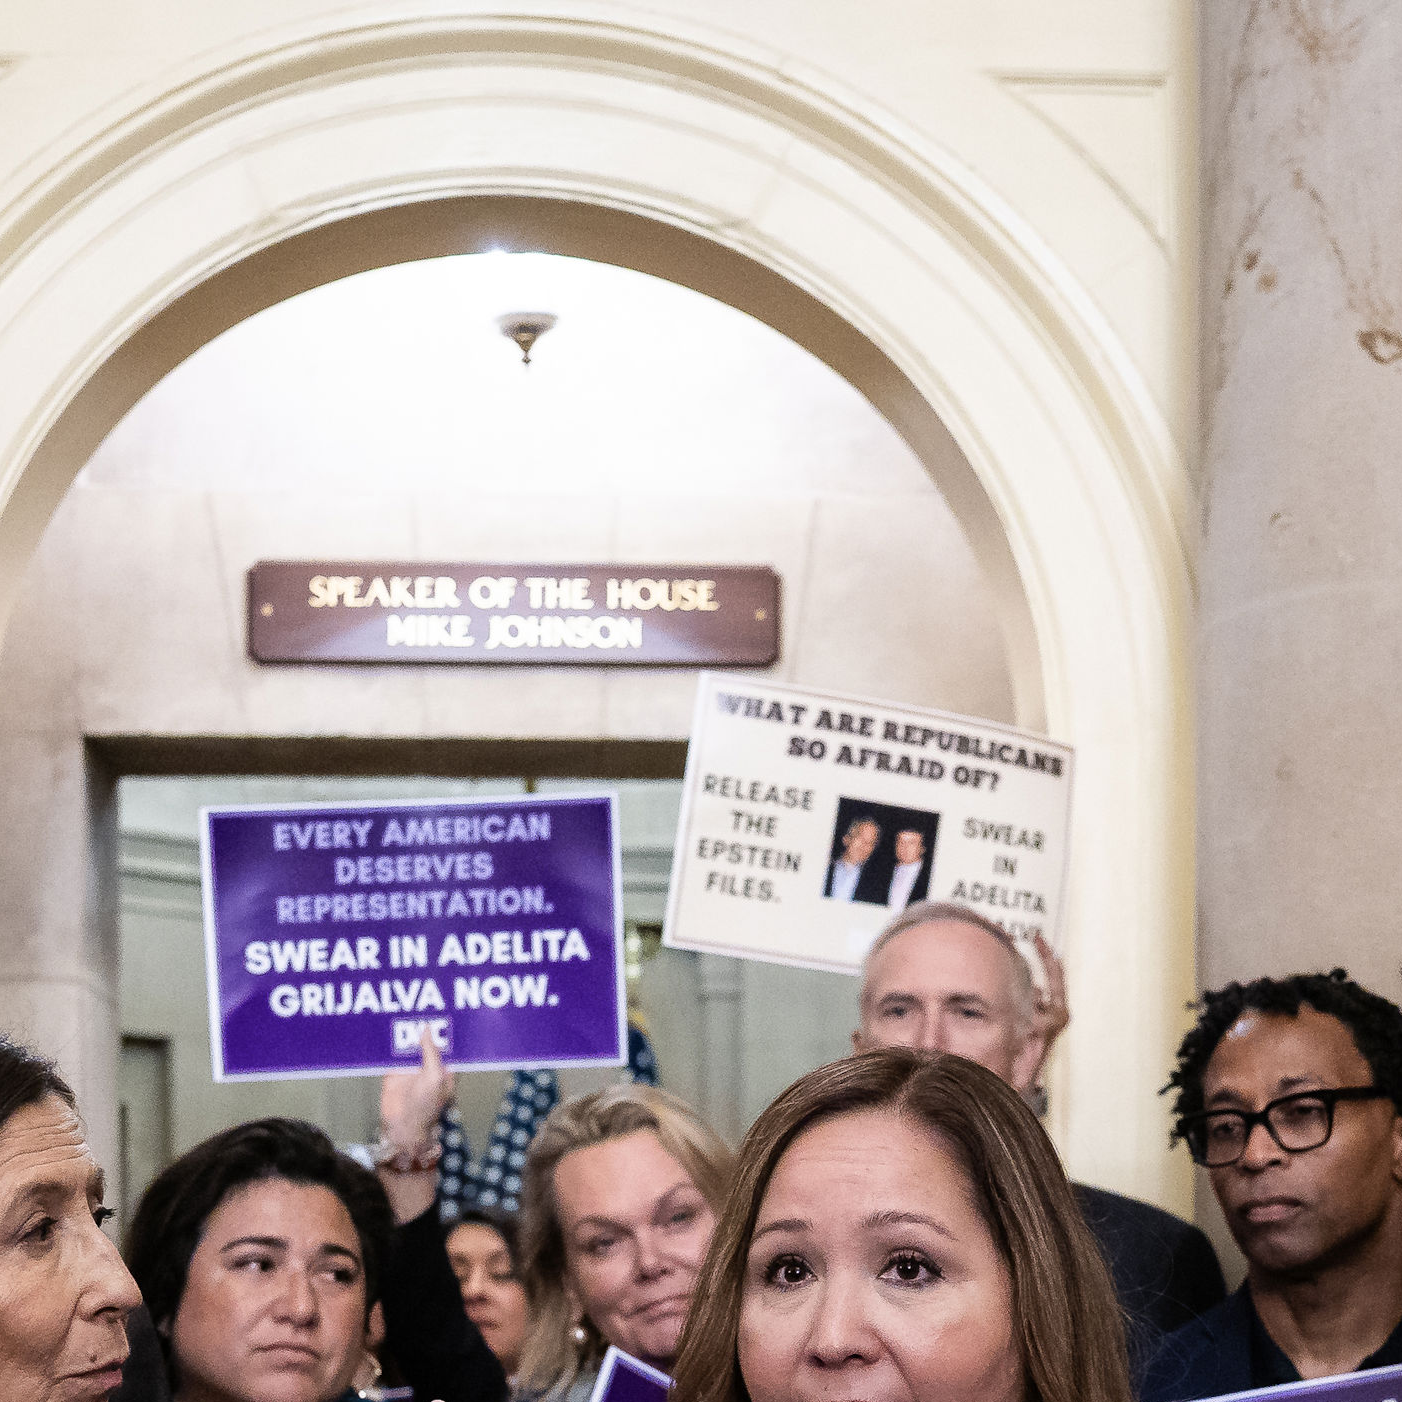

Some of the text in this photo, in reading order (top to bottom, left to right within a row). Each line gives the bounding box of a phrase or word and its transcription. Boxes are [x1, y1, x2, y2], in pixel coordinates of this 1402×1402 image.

[308, 575, 719, 612] SPEAKER OF THE HOUSE
[387, 615, 643, 650] MIKE JOHNSON
[716, 692, 1065, 778] WHAT ARE REPUBLICANS
[788, 736, 1001, 793] SO AFRAID OF?
[702, 774, 815, 811] RELEASE
[273, 813, 552, 851] EVERY AMERICAN
[730, 810, 779, 838] THE
[963, 817, 1046, 852] SWEAR
[334, 852, 494, 885] DESERVES
[697, 838, 802, 873] EPSTEIN
[993, 854, 1018, 876] IN
[276, 886, 554, 924] REPRESENTATION.
[704, 871, 782, 903] FILES.
[952, 880, 1047, 914] ADELITA
[244, 928, 591, 975] SWEAR IN ADELITA
[269, 973, 560, 1018] GRIJALVA NOW.
